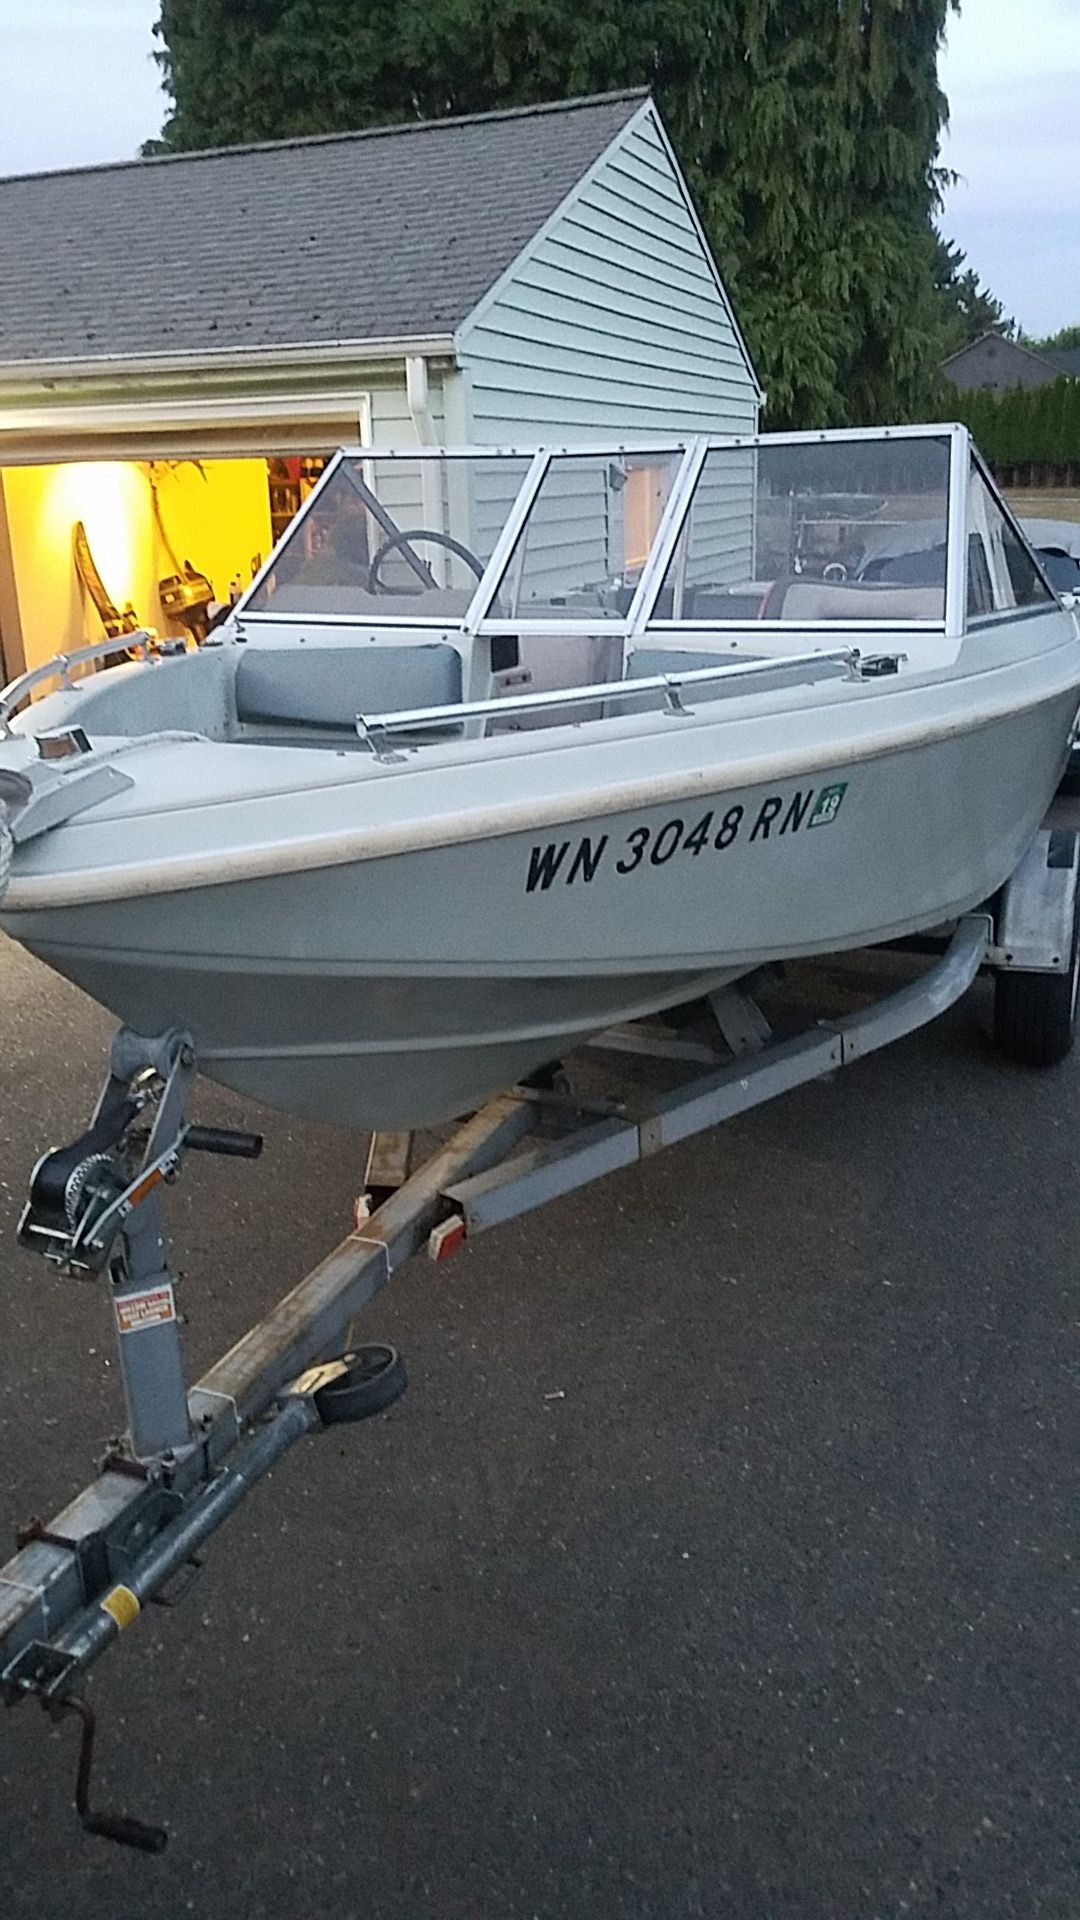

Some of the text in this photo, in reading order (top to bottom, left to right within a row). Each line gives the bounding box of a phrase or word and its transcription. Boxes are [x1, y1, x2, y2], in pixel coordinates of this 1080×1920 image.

[526, 789, 814, 893] WN 3048 RN
